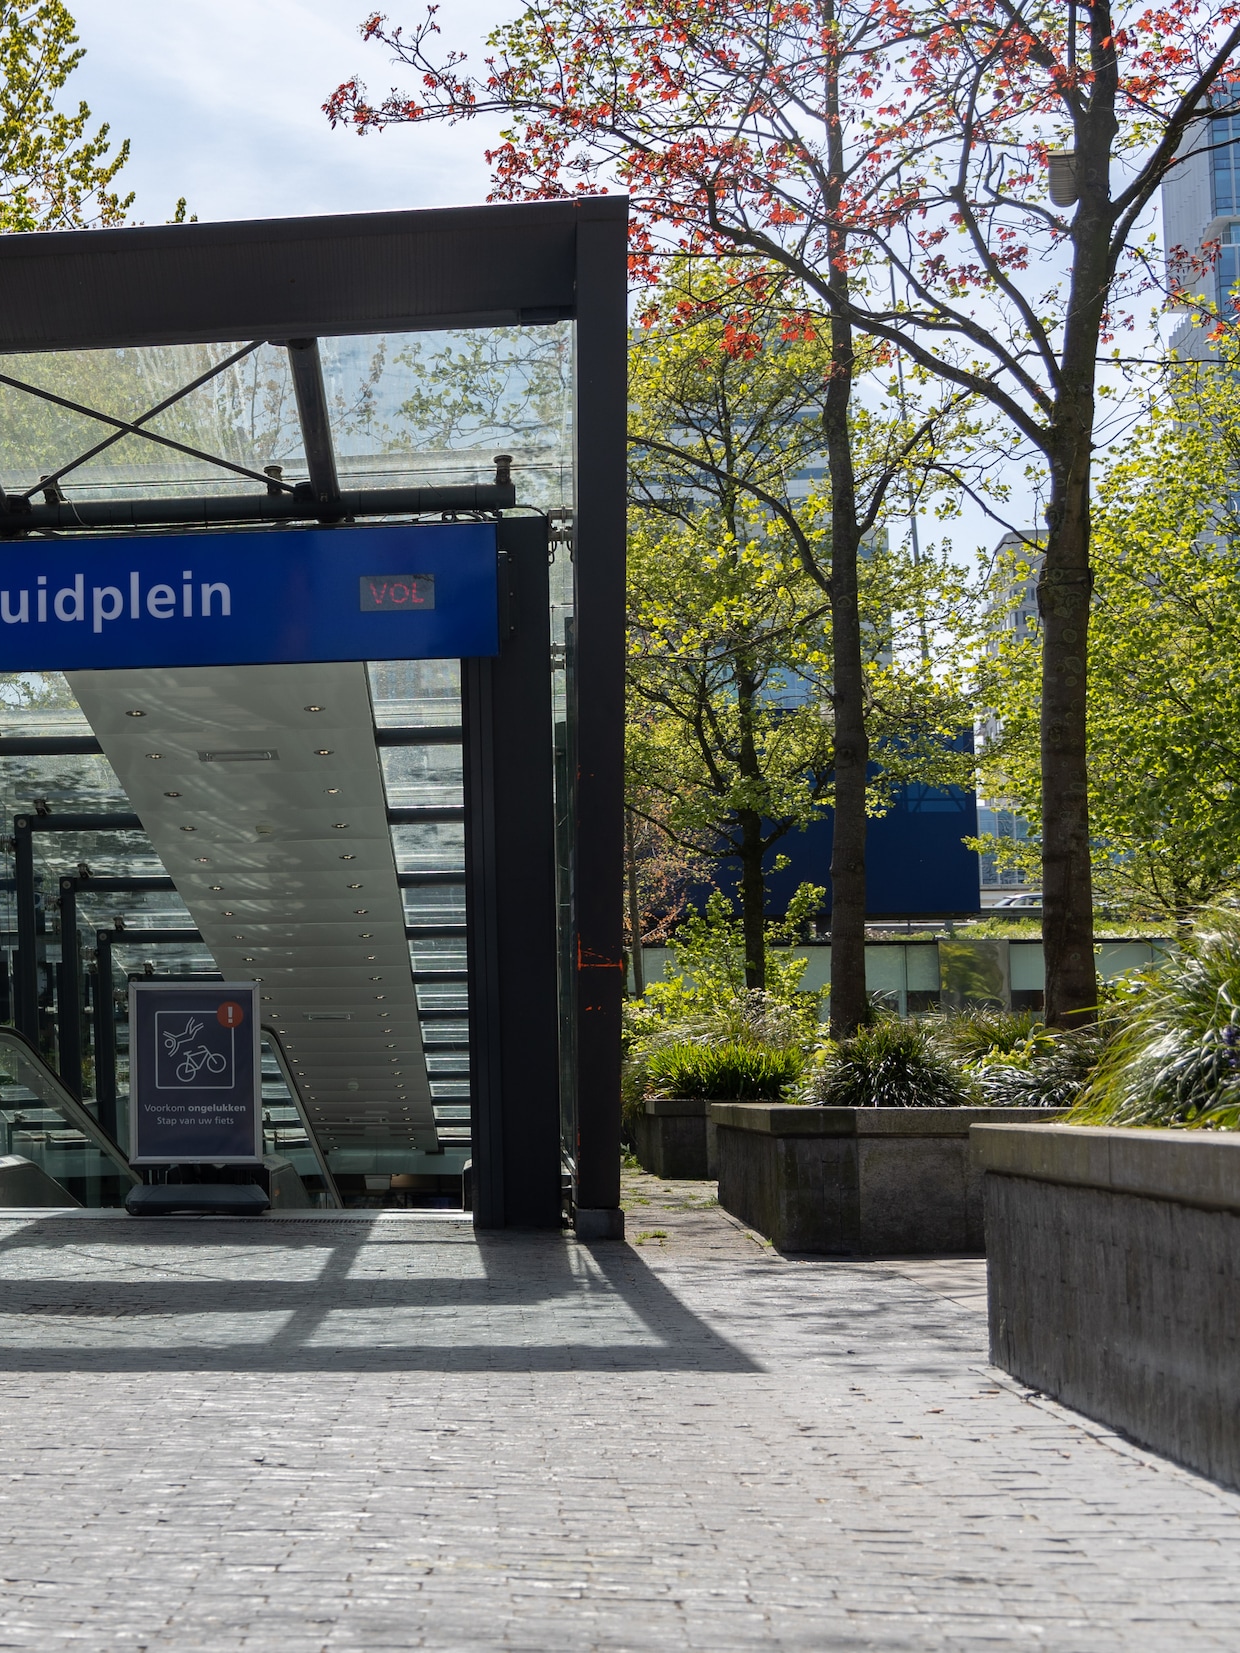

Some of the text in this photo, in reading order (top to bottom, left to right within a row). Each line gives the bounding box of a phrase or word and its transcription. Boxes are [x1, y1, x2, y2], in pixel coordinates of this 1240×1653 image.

[369, 582, 425, 604] VOL
[144, 1103, 246, 1114] Voorkom ongelukken
[157, 1116, 177, 1126] Stap
[215, 1116, 235, 1125] fiets
